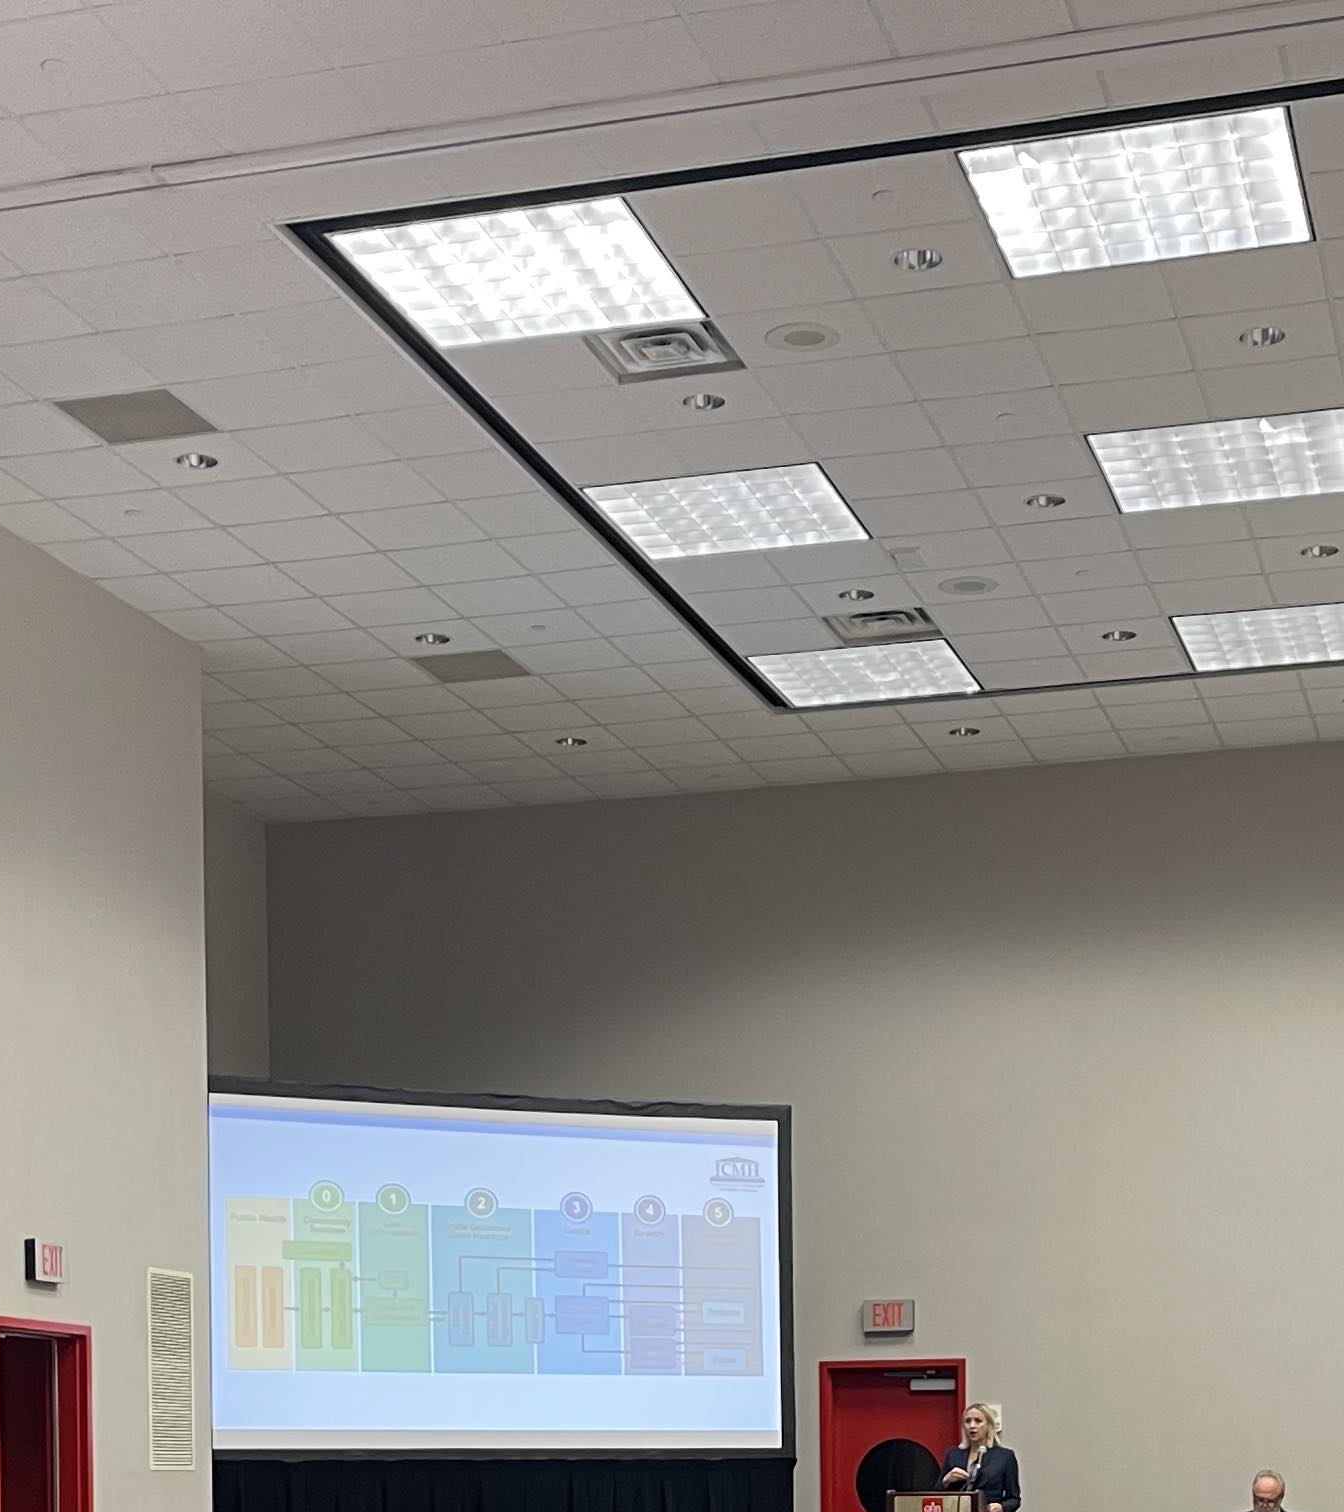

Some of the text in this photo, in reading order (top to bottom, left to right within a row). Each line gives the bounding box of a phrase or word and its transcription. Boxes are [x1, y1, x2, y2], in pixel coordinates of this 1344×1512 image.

[322, 1190, 331, 1202] 0
[389, 1193, 397, 1206] 1
[476, 1196, 486, 1209] 2
[572, 1201, 581, 1213] 3
[645, 1204, 654, 1216] 4
[714, 1206, 723, 1218] 5
[42, 1244, 63, 1278] EXIT
[872, 1303, 904, 1327] EXIT
